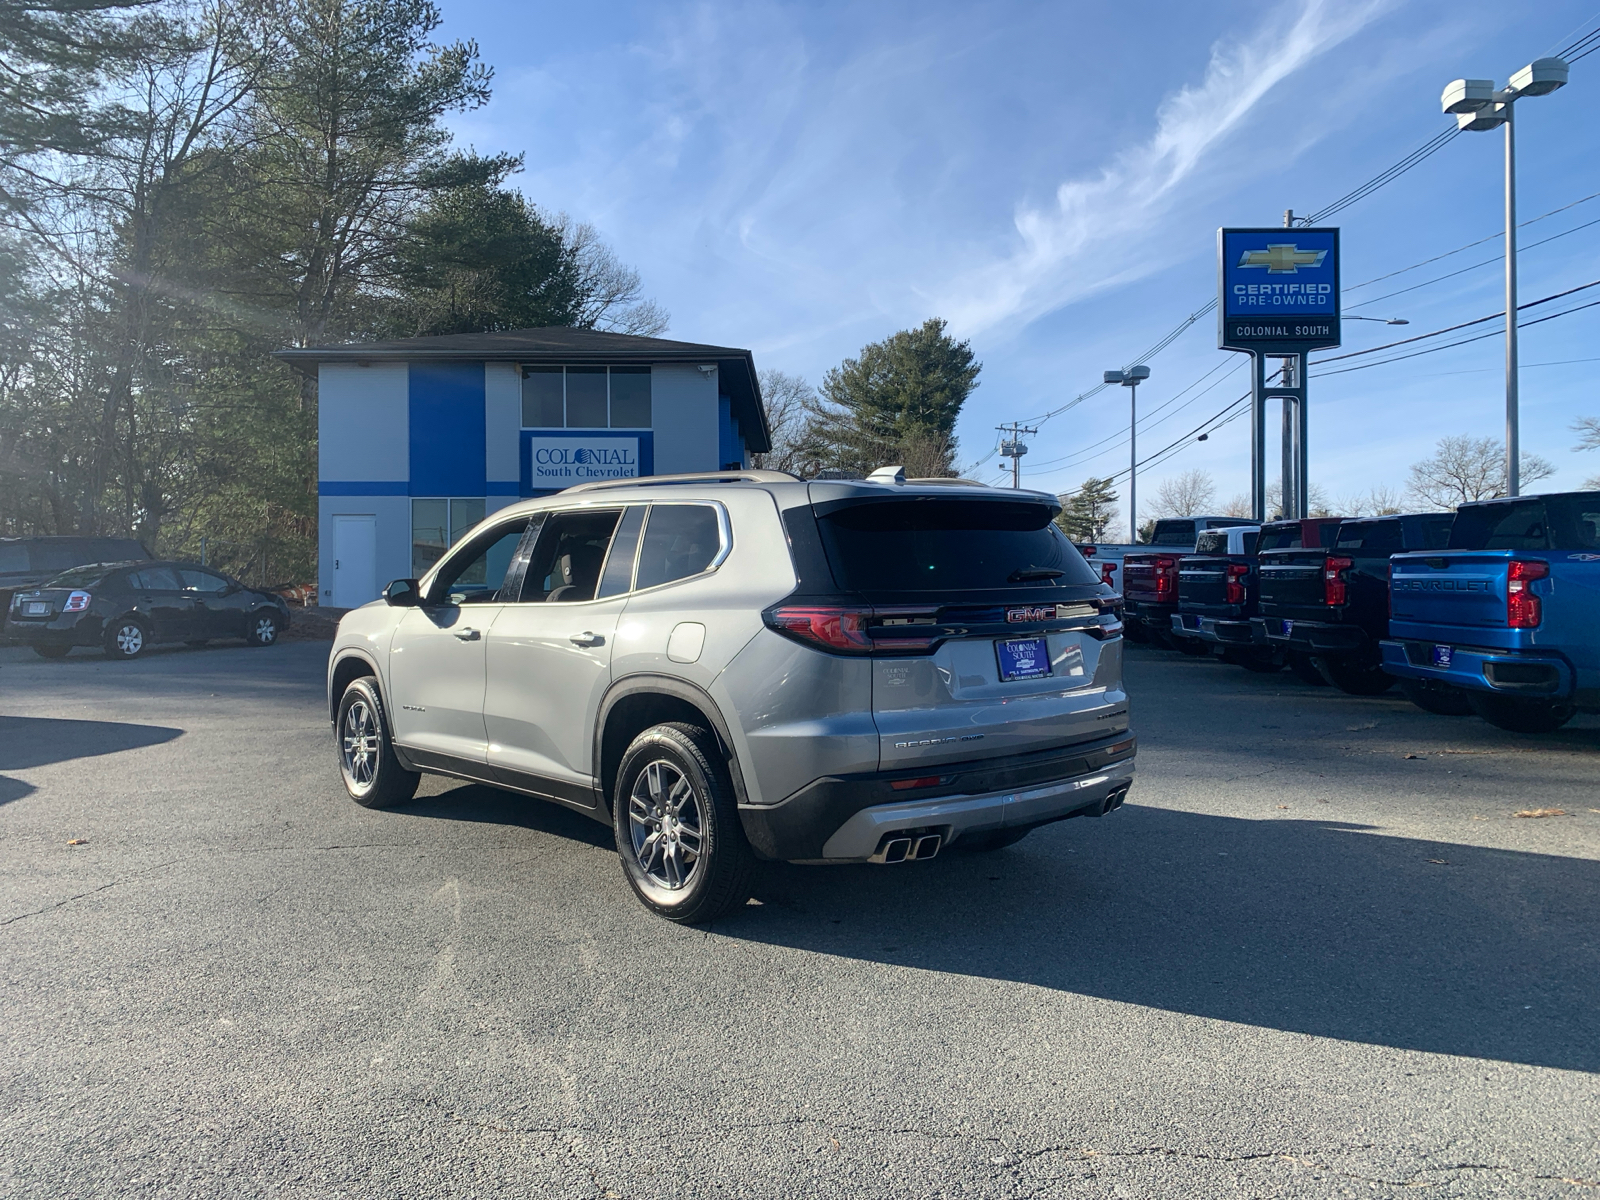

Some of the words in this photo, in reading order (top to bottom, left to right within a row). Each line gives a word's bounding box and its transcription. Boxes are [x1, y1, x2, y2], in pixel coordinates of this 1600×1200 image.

[1233, 283, 1331, 295] CERTIFIED
[1238, 295, 1326, 305] PRE-OWNED
[1236, 326, 1289, 336] COLONIAL
[1295, 325, 1329, 336] SOUTH
[535, 447, 635, 465] COLONIAL
[536, 466, 571, 477] South
[575, 466, 635, 477] Chevrolet
[1393, 580, 1493, 593] CHEVROLET
[1007, 607, 1056, 624] GMC
[1006, 643, 1038, 653] COLONIAL
[1012, 650, 1035, 660] SOUTH
